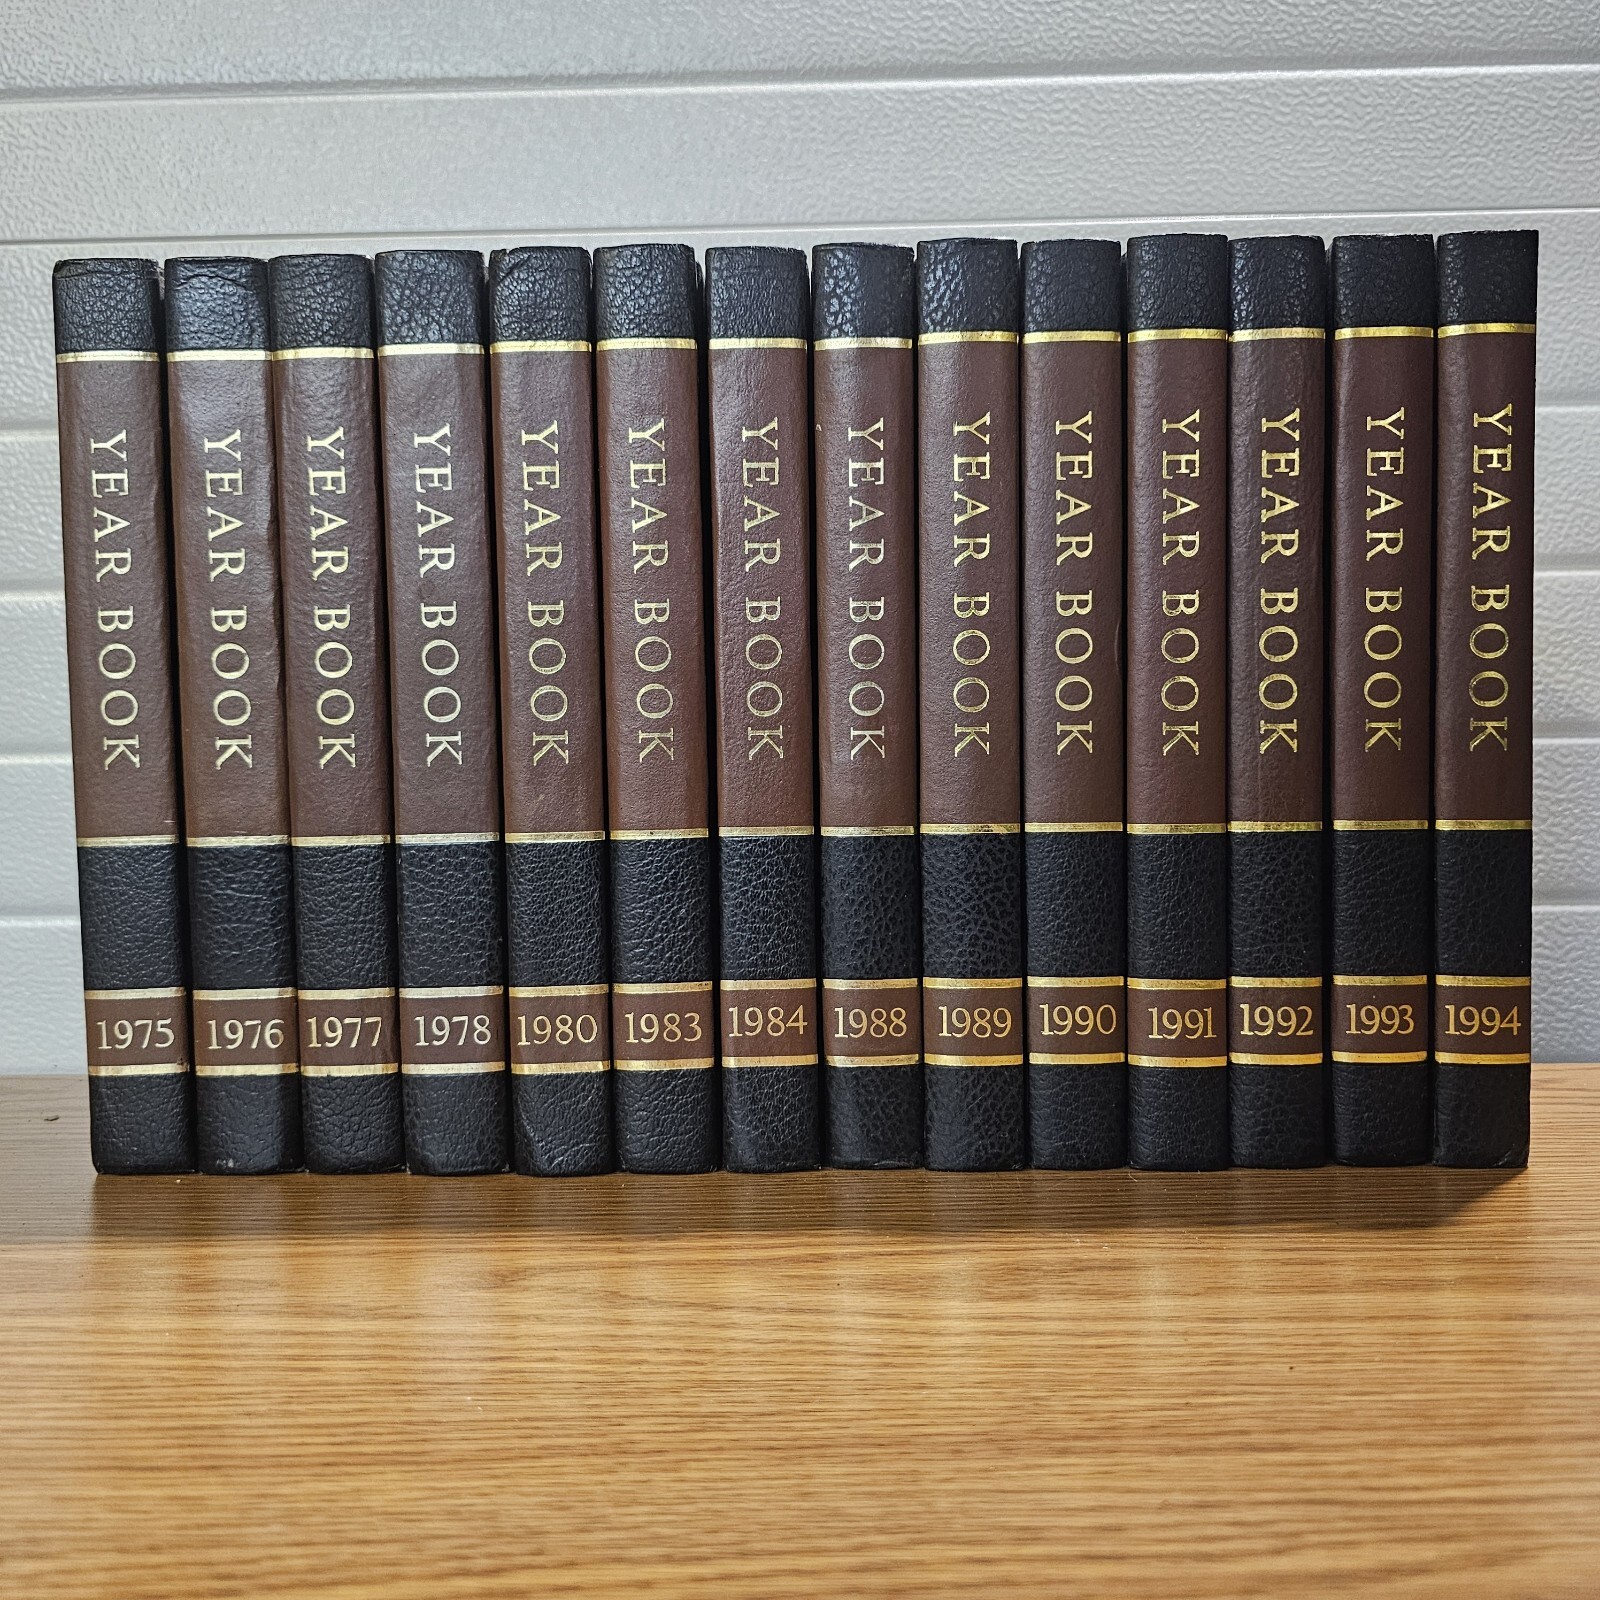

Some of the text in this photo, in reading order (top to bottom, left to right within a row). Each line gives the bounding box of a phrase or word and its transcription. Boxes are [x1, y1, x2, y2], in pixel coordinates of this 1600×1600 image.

[90, 429, 140, 770] YEAR BOOK
[203, 429, 252, 770] YEAR BOOK
[307, 426, 356, 769] YEAR BOOK
[413, 423, 462, 767] YEAR BOOK
[521, 420, 569, 766] YEAR BOOK
[628, 418, 674, 763] YEAR BOOK
[741, 417, 783, 760] YEAR BOOK
[847, 417, 886, 762] YEAR BOOK
[950, 411, 990, 757] YEAR BOOK
[1055, 411, 1093, 755] YEAR BOOK
[1161, 409, 1200, 756] YEAR BOOK
[1259, 408, 1300, 754] YEAR BOOK
[1364, 407, 1404, 752] YEAR BOOK
[1469, 404, 1512, 751] YEAR BOOK
[96, 1018, 175, 1050] 1975
[206, 1019, 285, 1050] 1976
[306, 1015, 383, 1048] 1977
[413, 1015, 492, 1046] 1978
[518, 1015, 597, 1045] 1980
[625, 1012, 701, 1043] 1983
[729, 1005, 807, 1037] 1984
[834, 1007, 906, 1039] 1988
[939, 1006, 1011, 1037] 1989
[1039, 1004, 1116, 1035] 1990
[1148, 1007, 1216, 1039] 1991
[1240, 1004, 1313, 1036] 1992
[1346, 1004, 1414, 1034] 1993
[1445, 1005, 1521, 1035] 1994
